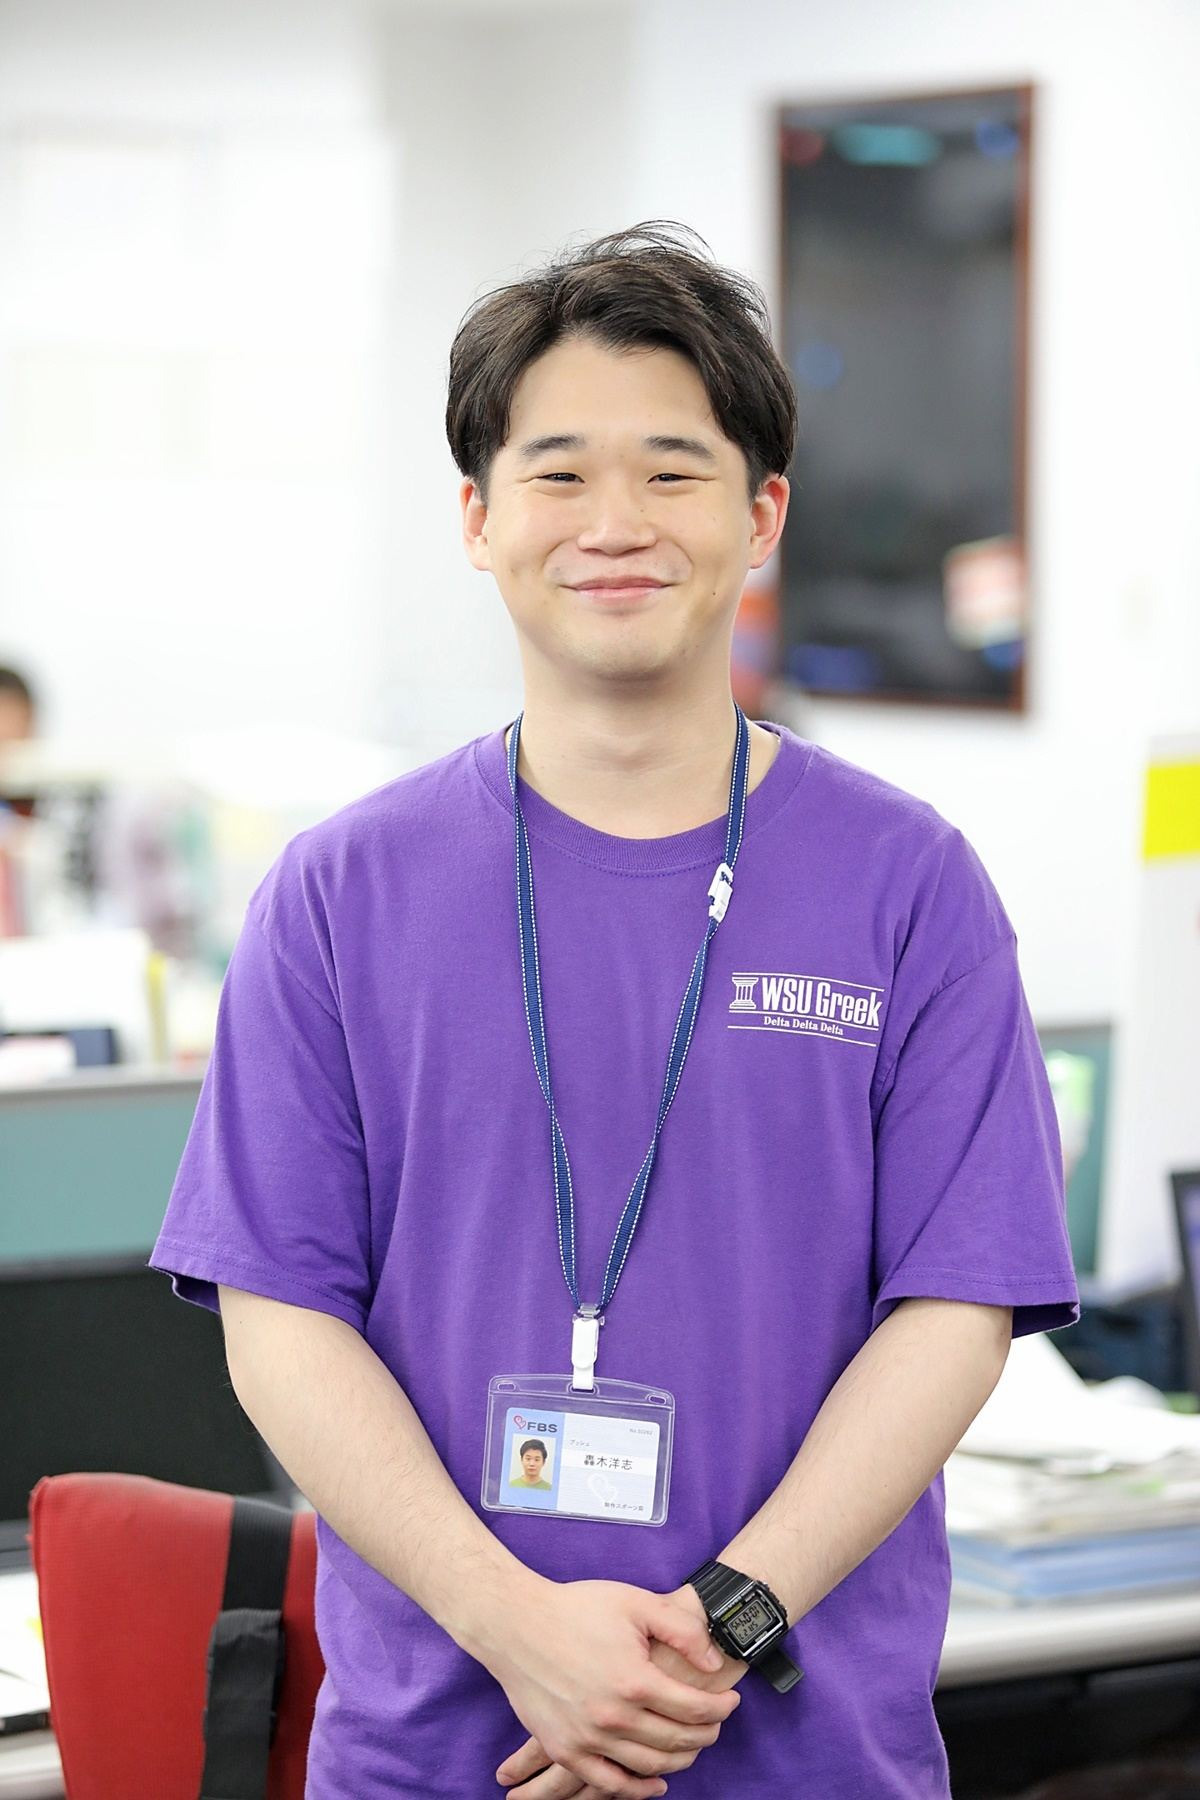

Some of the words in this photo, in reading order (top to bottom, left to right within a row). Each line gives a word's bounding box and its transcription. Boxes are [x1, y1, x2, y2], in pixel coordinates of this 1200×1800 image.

[761, 976, 813, 1015] WSU
[815, 982, 882, 1027] Greek
[763, 1016, 790, 1027] Delta
[792, 1018, 818, 1031] Delta
[820, 1023, 843, 1035] Delta
[527, 1421, 558, 1433] FBS
